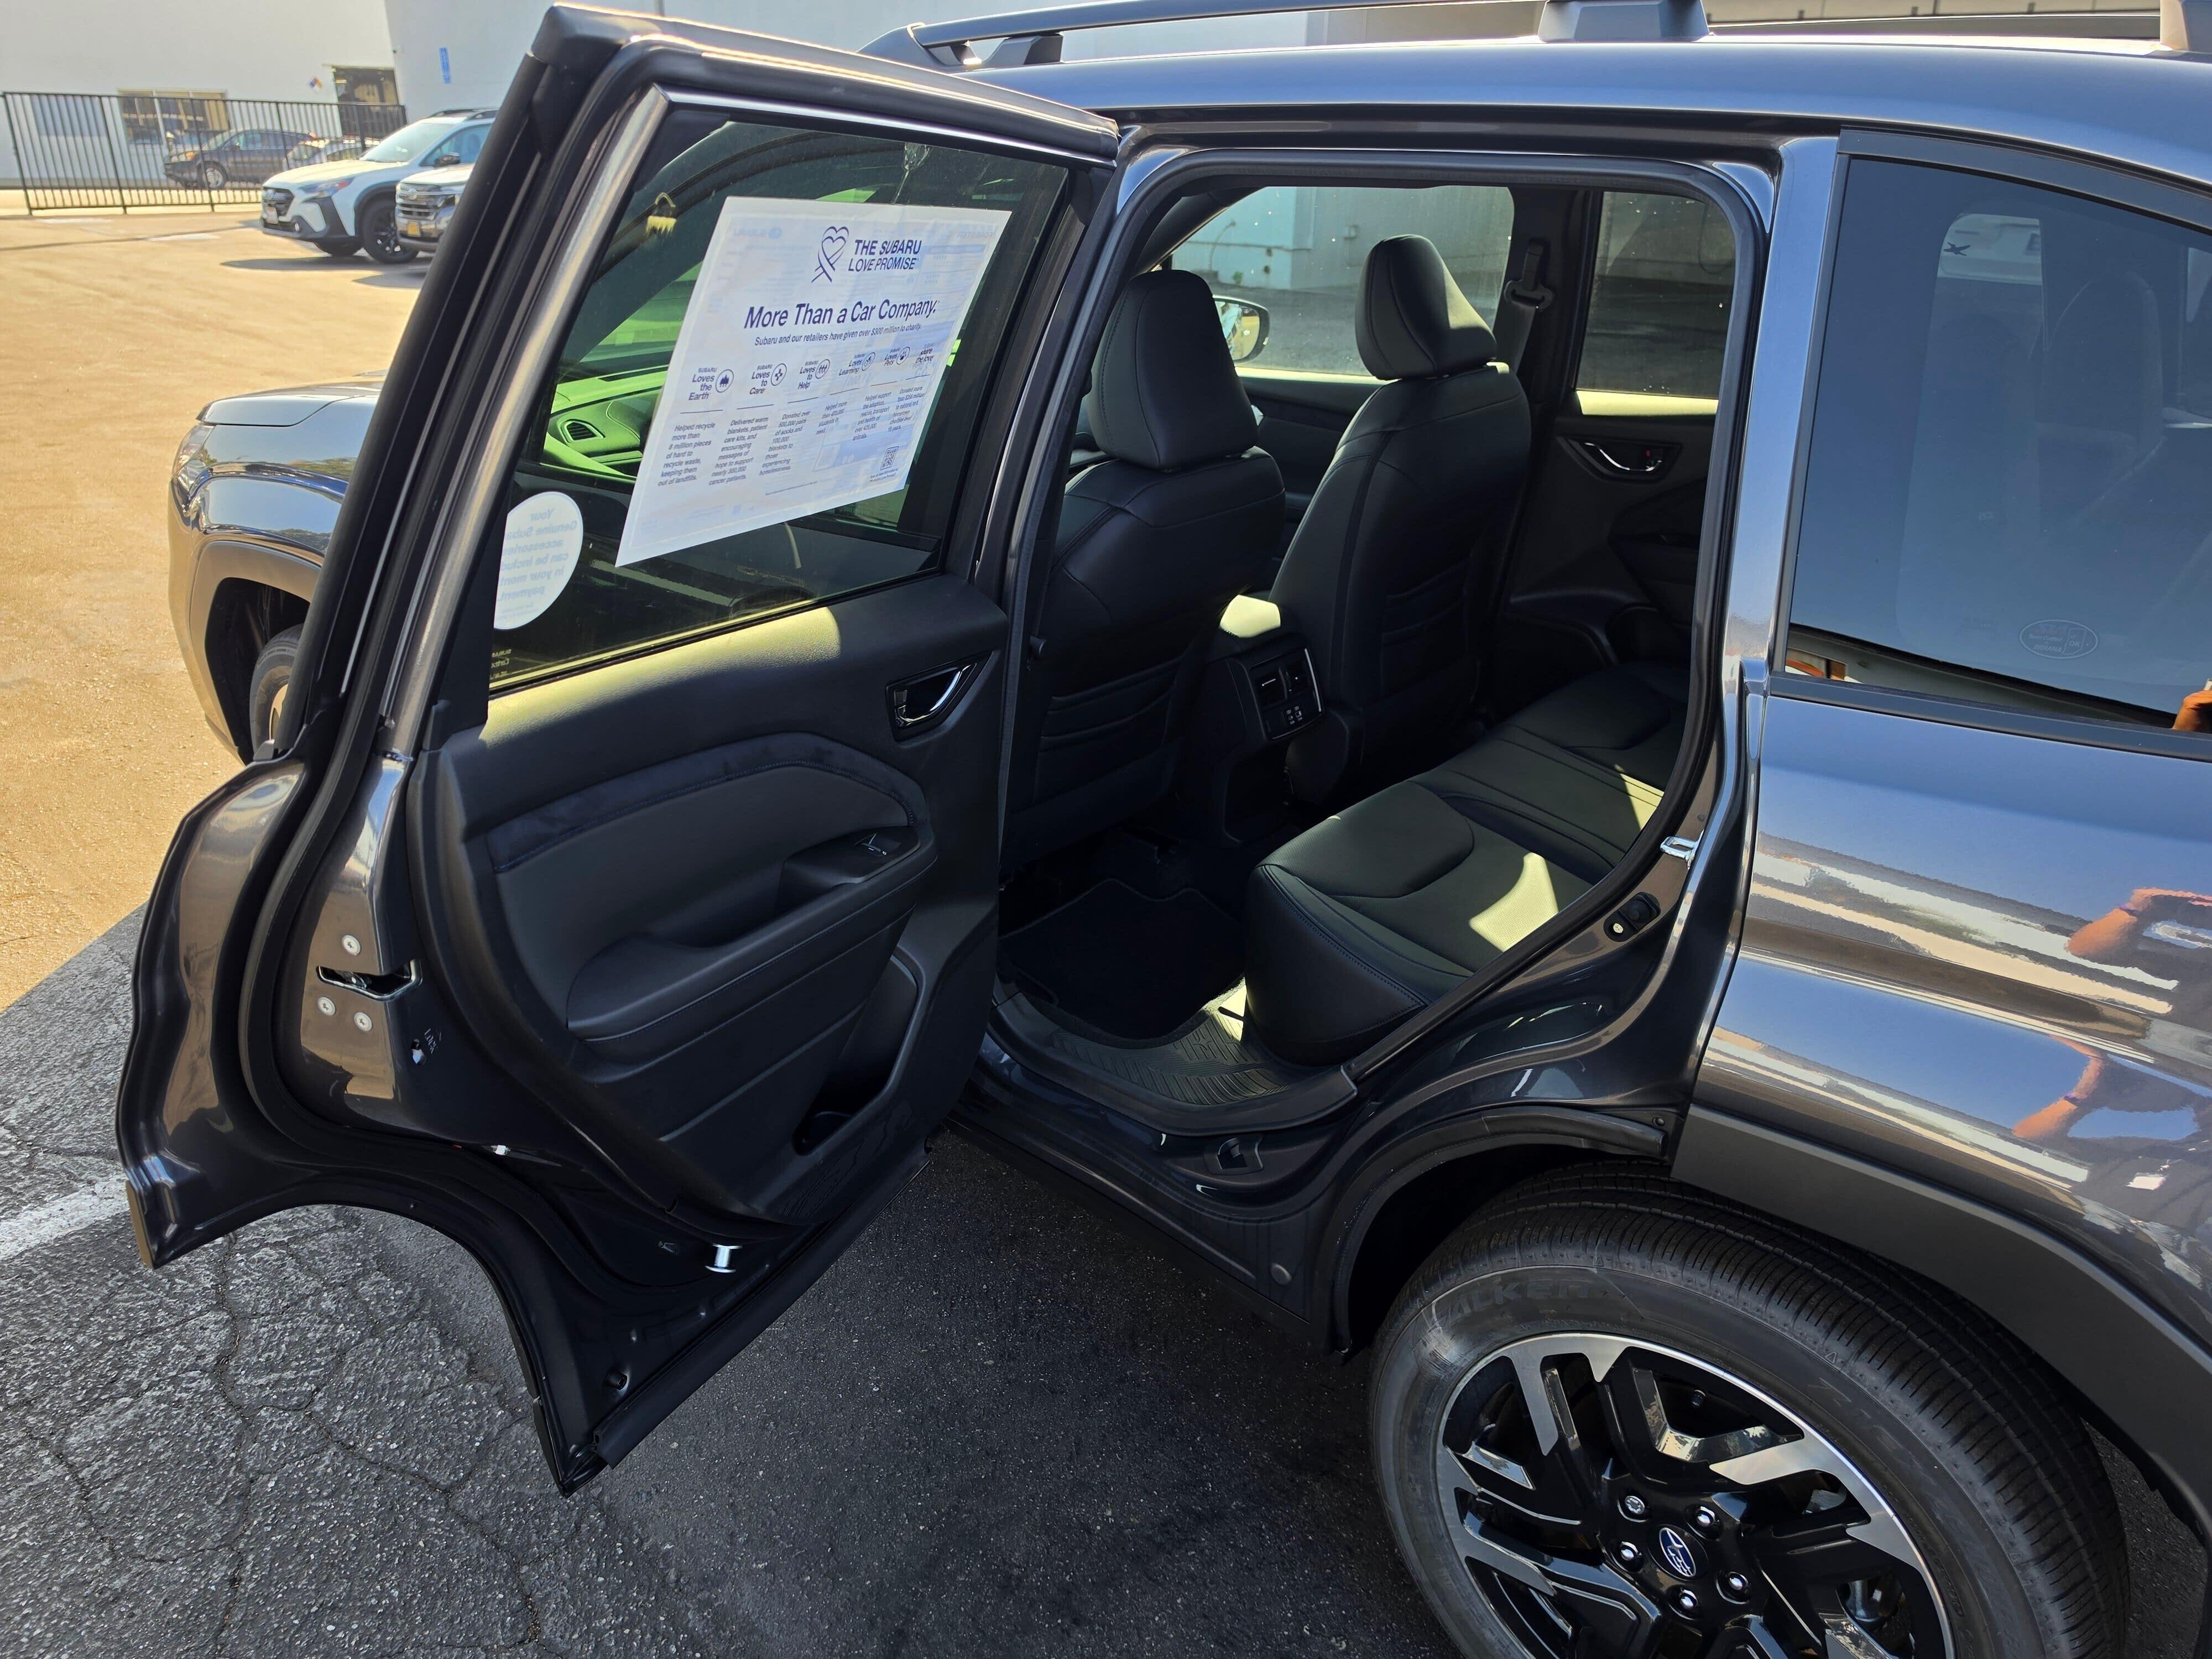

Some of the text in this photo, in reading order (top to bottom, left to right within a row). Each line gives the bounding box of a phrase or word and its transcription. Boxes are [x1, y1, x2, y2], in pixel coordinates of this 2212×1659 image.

[854, 239, 922, 255] THE SUBARU
[848, 258, 916, 272] LOVE PROMISE
[744, 299, 936, 328] More Than a Car Company.
[755, 337, 778, 346] Subaru
[779, 335, 790, 343] and
[804, 332, 828, 341] retailers
[830, 332, 843, 341] have
[843, 331, 858, 341] given
[752, 371, 770, 379] Loves
[839, 367, 860, 376] Learning
[692, 374, 715, 383] Loves
[700, 383, 712, 392] the
[798, 381, 810, 390] Help
[688, 392, 709, 400] Earth
[731, 418, 755, 426] Delivered
[675, 422, 715, 432] Helped recycle
[750, 424, 768, 432] patient
[693, 440, 712, 448] pieces
[721, 442, 752, 452] encouraging
[718, 452, 743, 461] messages
[664, 460, 684, 469] recycle
[734, 457, 754, 466] support
[661, 469, 682, 478] keeping
[2033, 644, 2062, 653] INDIANA
[424, 1027, 438, 1055] LOCK
